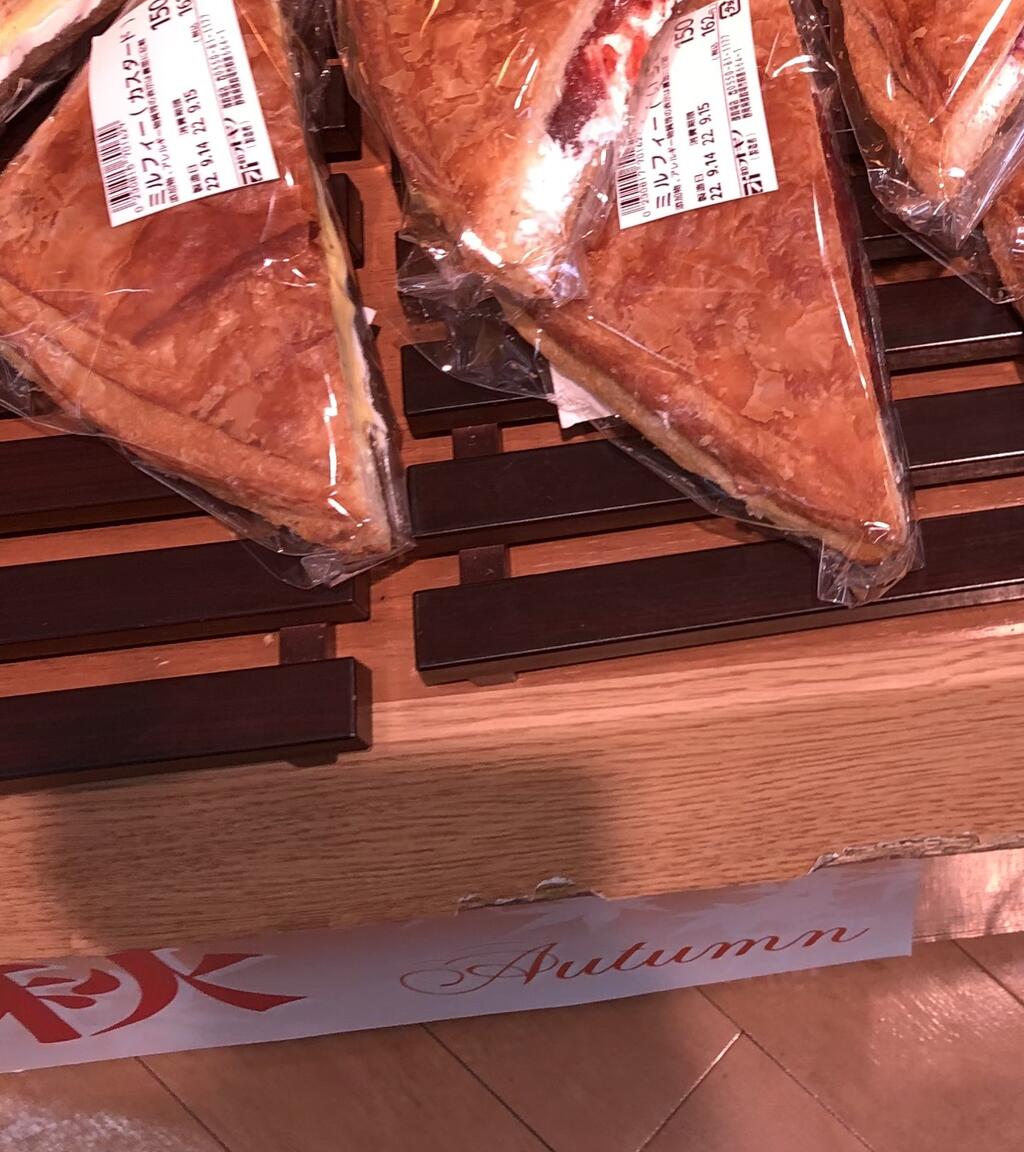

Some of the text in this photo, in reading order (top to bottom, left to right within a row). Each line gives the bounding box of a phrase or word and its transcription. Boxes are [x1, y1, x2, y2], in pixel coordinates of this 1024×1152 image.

[673, 18, 694, 49] 150
[120, 17, 168, 207] ミルフィー（カスタード）
[183, 88, 201, 113] 9.15
[698, 102, 711, 126] 9.15
[196, 141, 214, 168] 9.14
[707, 152, 720, 178] 9.14
[399, 925, 872, 996] Autumn
